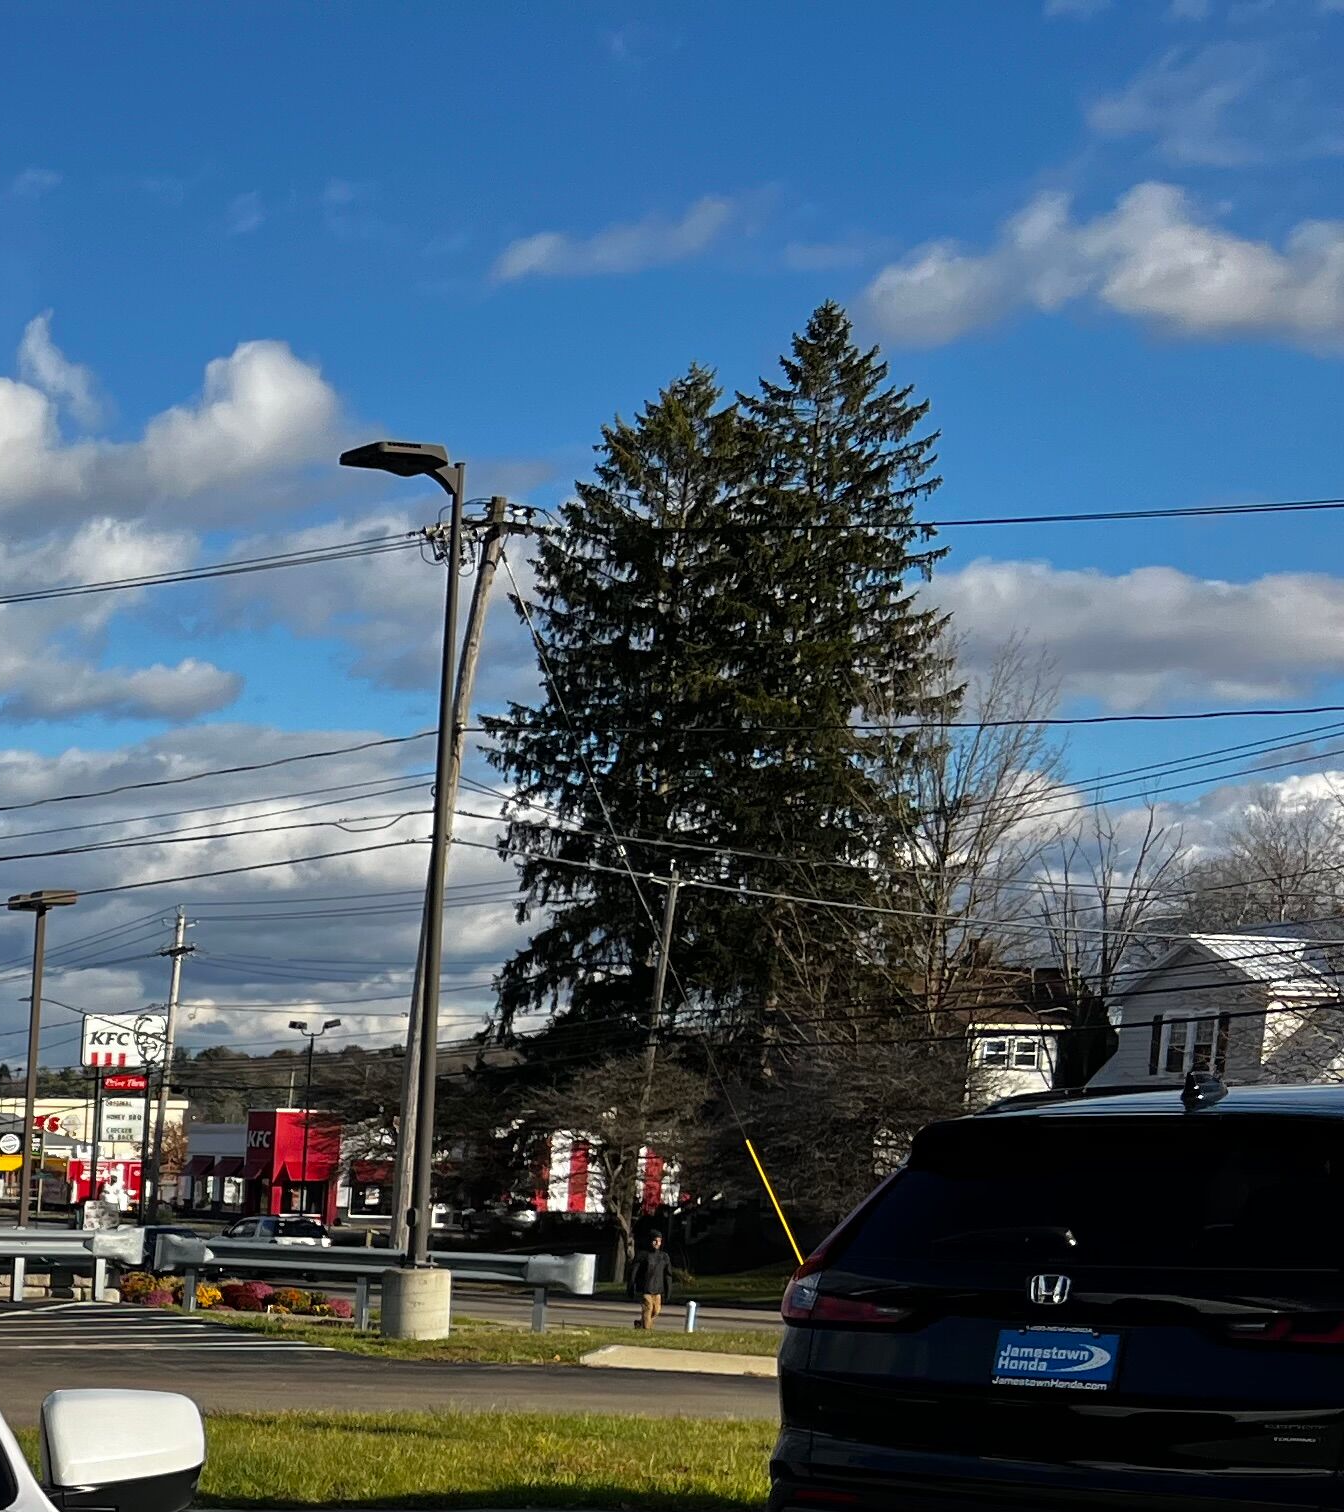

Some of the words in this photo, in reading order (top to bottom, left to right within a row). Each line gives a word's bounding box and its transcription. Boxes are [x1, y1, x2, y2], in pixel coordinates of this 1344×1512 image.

[89, 1031, 130, 1046] KFC
[247, 1130, 272, 1148] KFC
[1000, 1344, 1090, 1361] Jamestown
[997, 1356, 1048, 1372] Honda
[992, 1376, 1108, 1391] JamestownHonda.com
